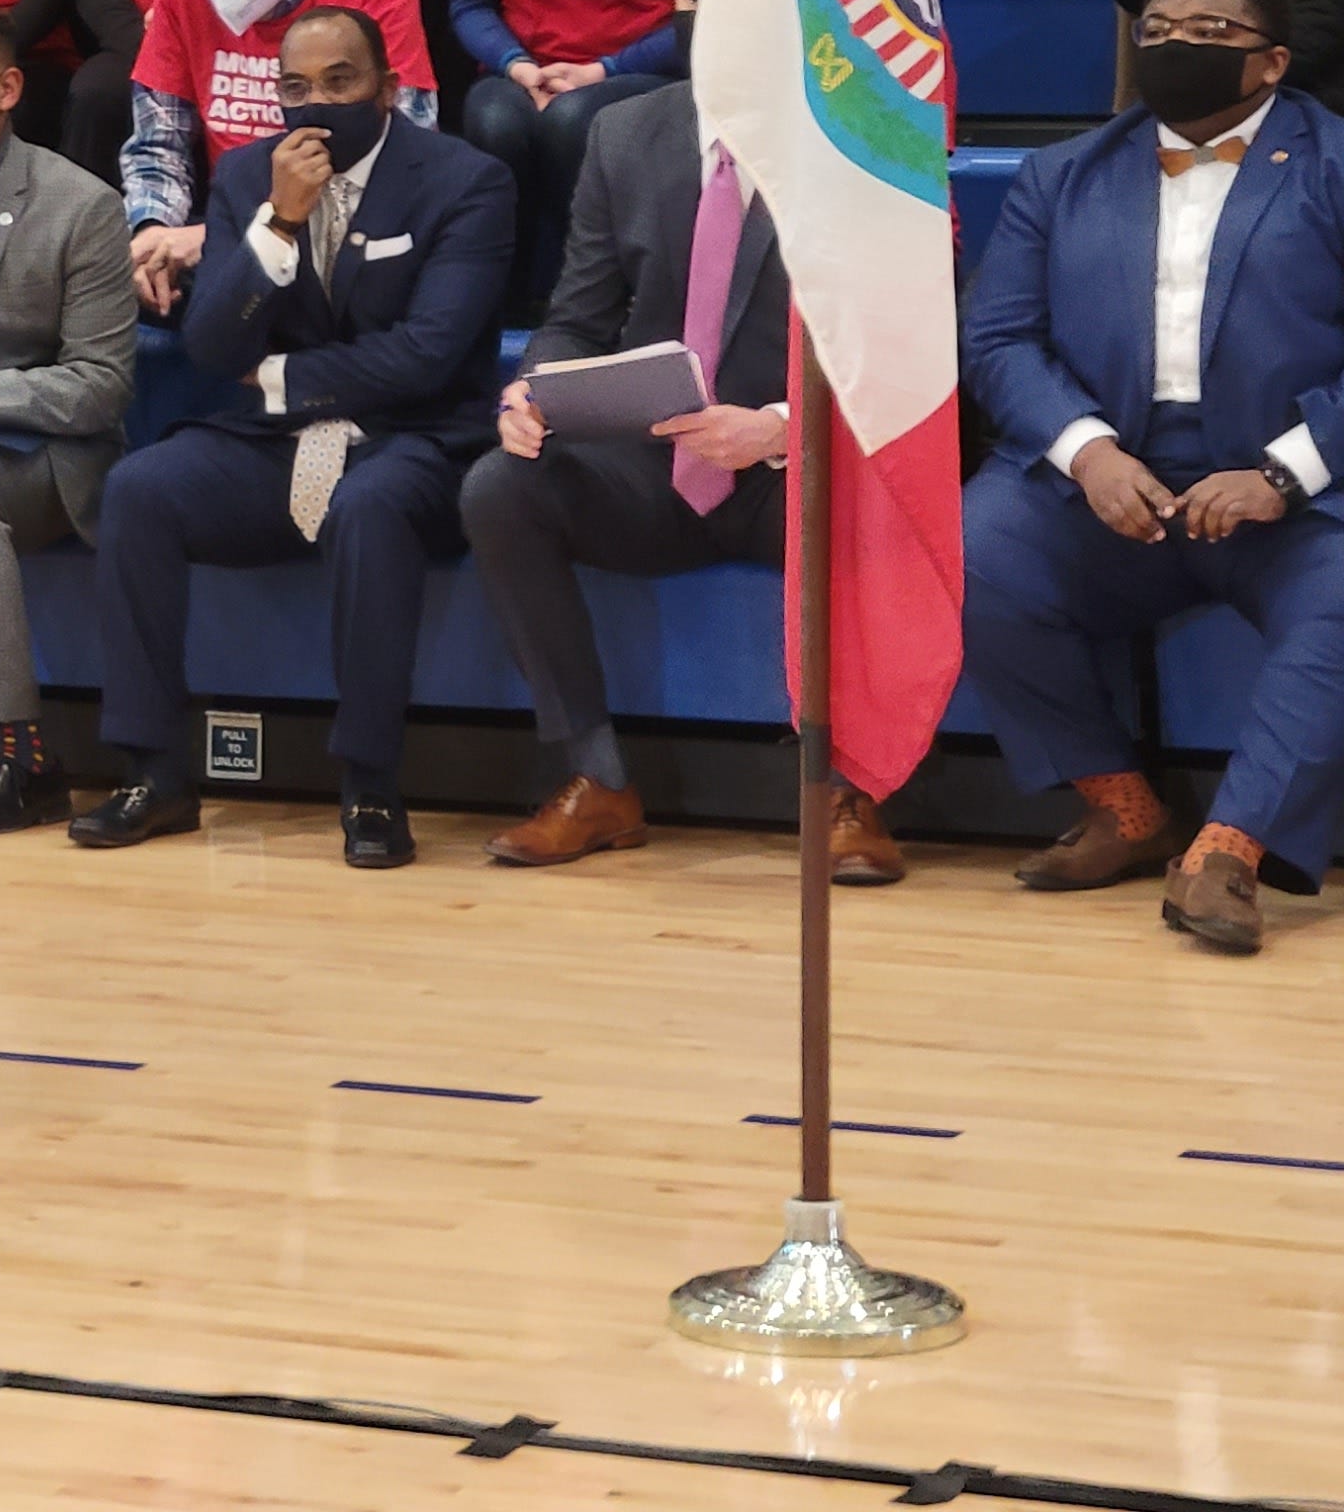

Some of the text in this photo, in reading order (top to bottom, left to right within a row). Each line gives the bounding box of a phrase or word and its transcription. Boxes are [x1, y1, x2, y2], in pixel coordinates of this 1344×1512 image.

[222, 730, 248, 741] PULL
[227, 743, 242, 754] TO
[213, 756, 255, 768] UNLOCK
